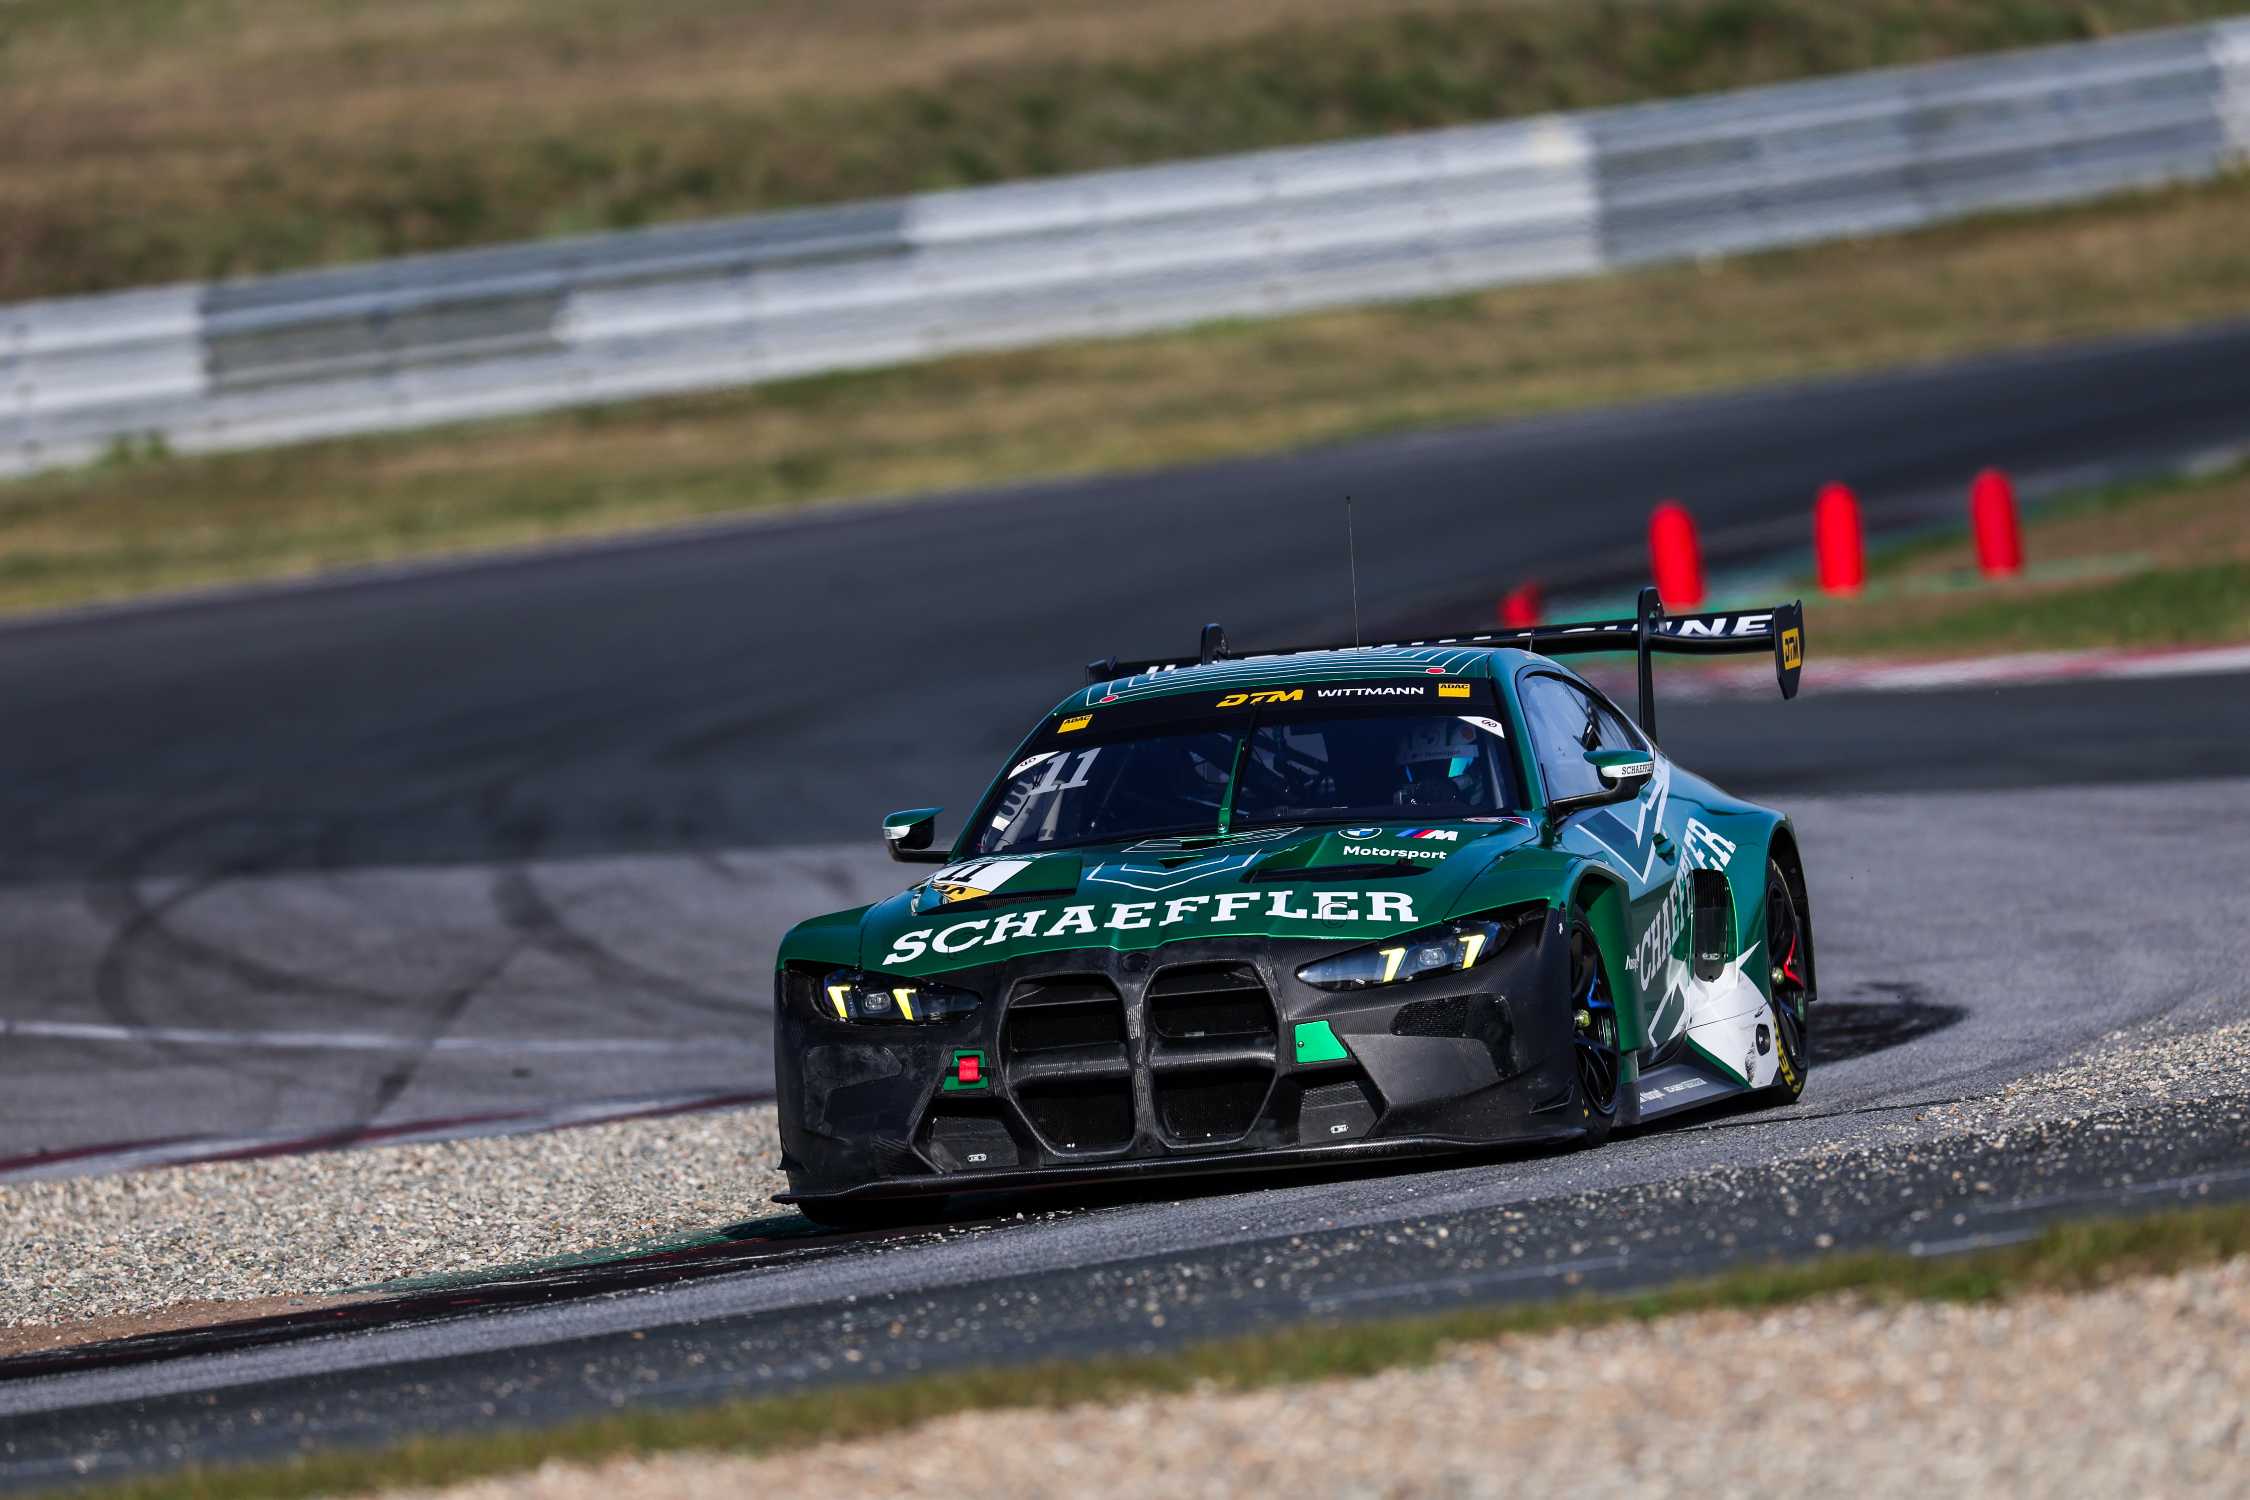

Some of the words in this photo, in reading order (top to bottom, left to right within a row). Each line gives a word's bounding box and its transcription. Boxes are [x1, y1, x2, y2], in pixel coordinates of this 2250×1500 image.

[1216, 689, 1304, 708] DTM
[1317, 686, 1425, 698] WITTMANN
[1029, 747, 1102, 795] 11
[1343, 845, 1447, 860] Motorsport
[881, 890, 1419, 966] SCHAEFFLER
